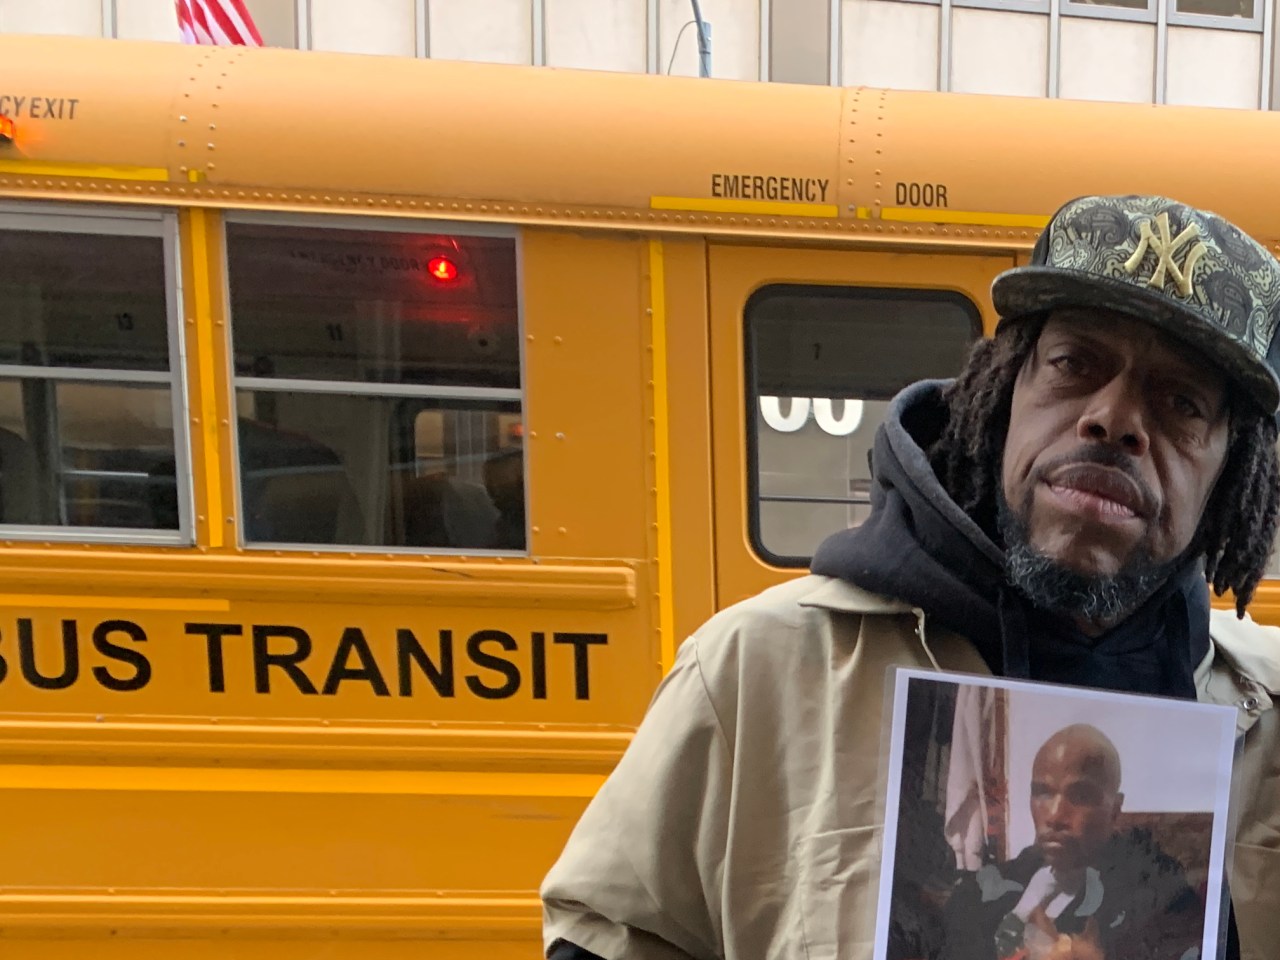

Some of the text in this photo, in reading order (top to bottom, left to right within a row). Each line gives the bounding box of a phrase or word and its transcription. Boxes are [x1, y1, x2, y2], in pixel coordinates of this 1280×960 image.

[29, 96, 80, 120] EXIT
[711, 173, 949, 207] EMERGENCY DOOR
[1123, 210, 1208, 298] NY
[184, 622, 608, 701] TRANSIT
